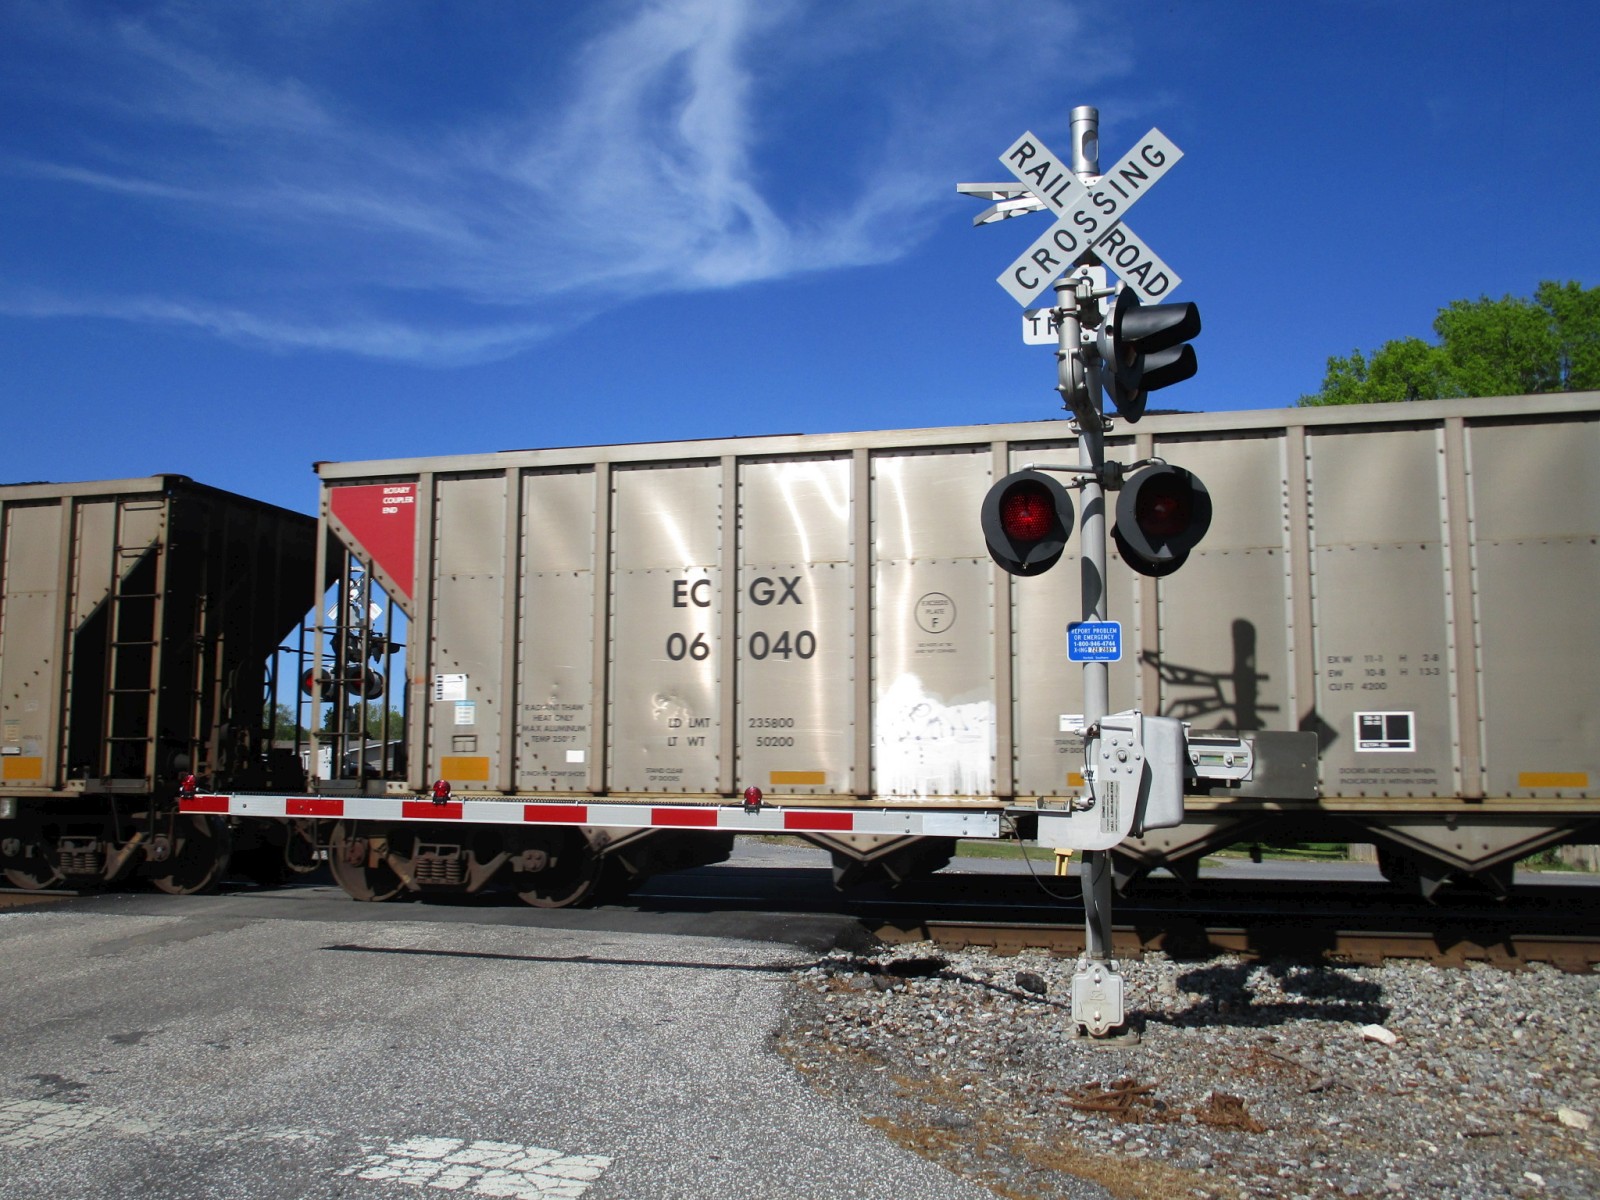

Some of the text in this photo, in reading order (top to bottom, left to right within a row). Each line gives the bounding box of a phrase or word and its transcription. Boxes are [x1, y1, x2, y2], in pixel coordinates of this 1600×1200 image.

[1009, 140, 1169, 297] RAIL ROAD
[1014, 144, 1166, 290] CROSSING
[383, 496, 414, 504] COUPLER
[382, 506, 398, 514] END
[672, 576, 804, 608] EC GX
[931, 617, 939, 628] F
[667, 630, 816, 661] 06 040
[1399, 654, 1407, 662] H
[1400, 668, 1408, 676] H
[532, 714, 574, 722] HEAT ONLY
[668, 717, 795, 729] LD LMT 235800
[531, 735, 551, 743] TEMP
[667, 736, 795, 747] LT WT 50200
